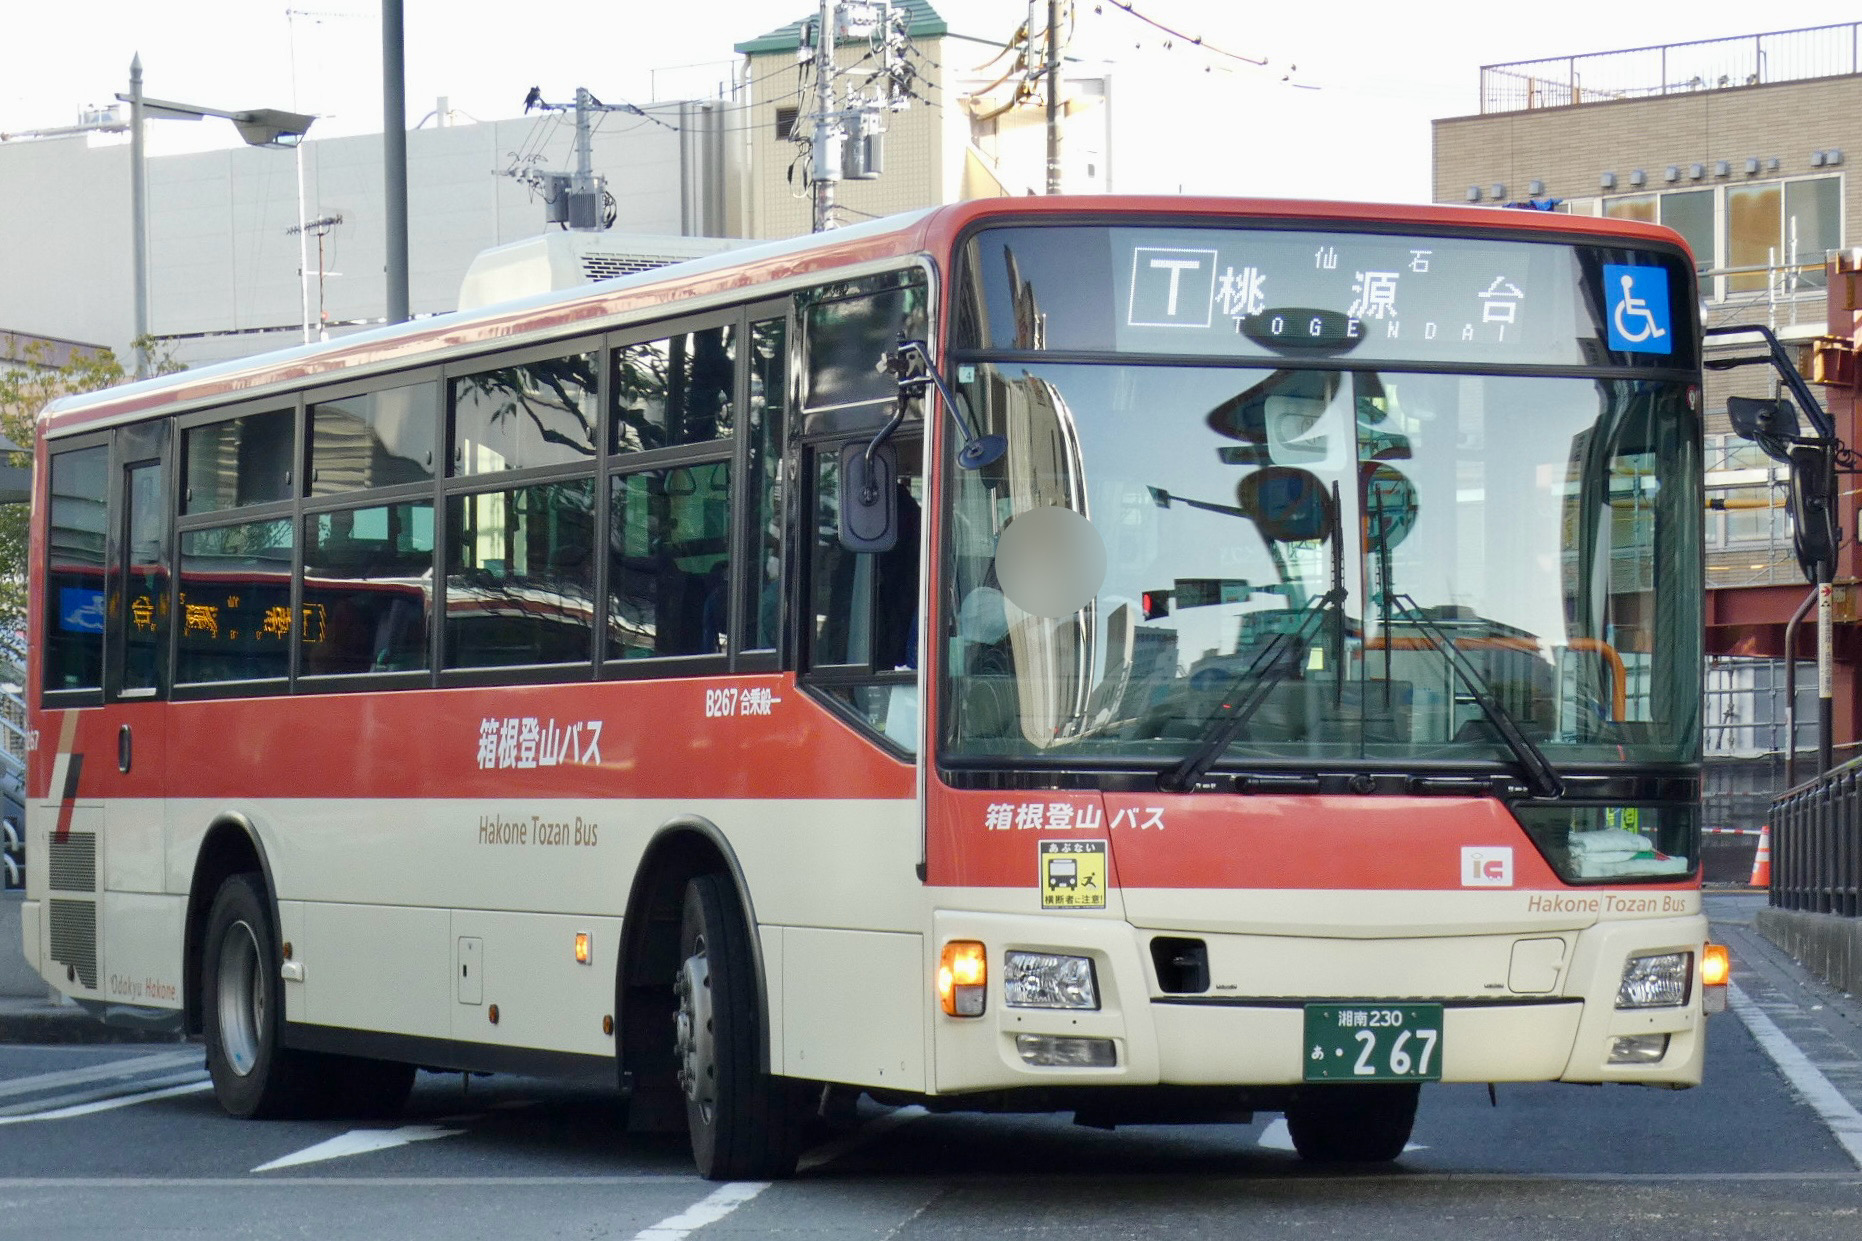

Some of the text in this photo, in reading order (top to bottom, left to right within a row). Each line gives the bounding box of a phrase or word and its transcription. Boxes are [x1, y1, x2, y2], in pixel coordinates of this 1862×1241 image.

[1150, 259, 1200, 316] T
[1215, 267, 1524, 324] 桃源台
[706, 687, 738, 717] B267
[477, 717, 603, 769] 箱根登山バス
[479, 815, 598, 846] Hakone Tozan Bus
[1048, 843, 1096, 853] あぶない
[1528, 895, 1686, 913] Hakone Tozan Bus
[145, 977, 176, 1000] Hakone
